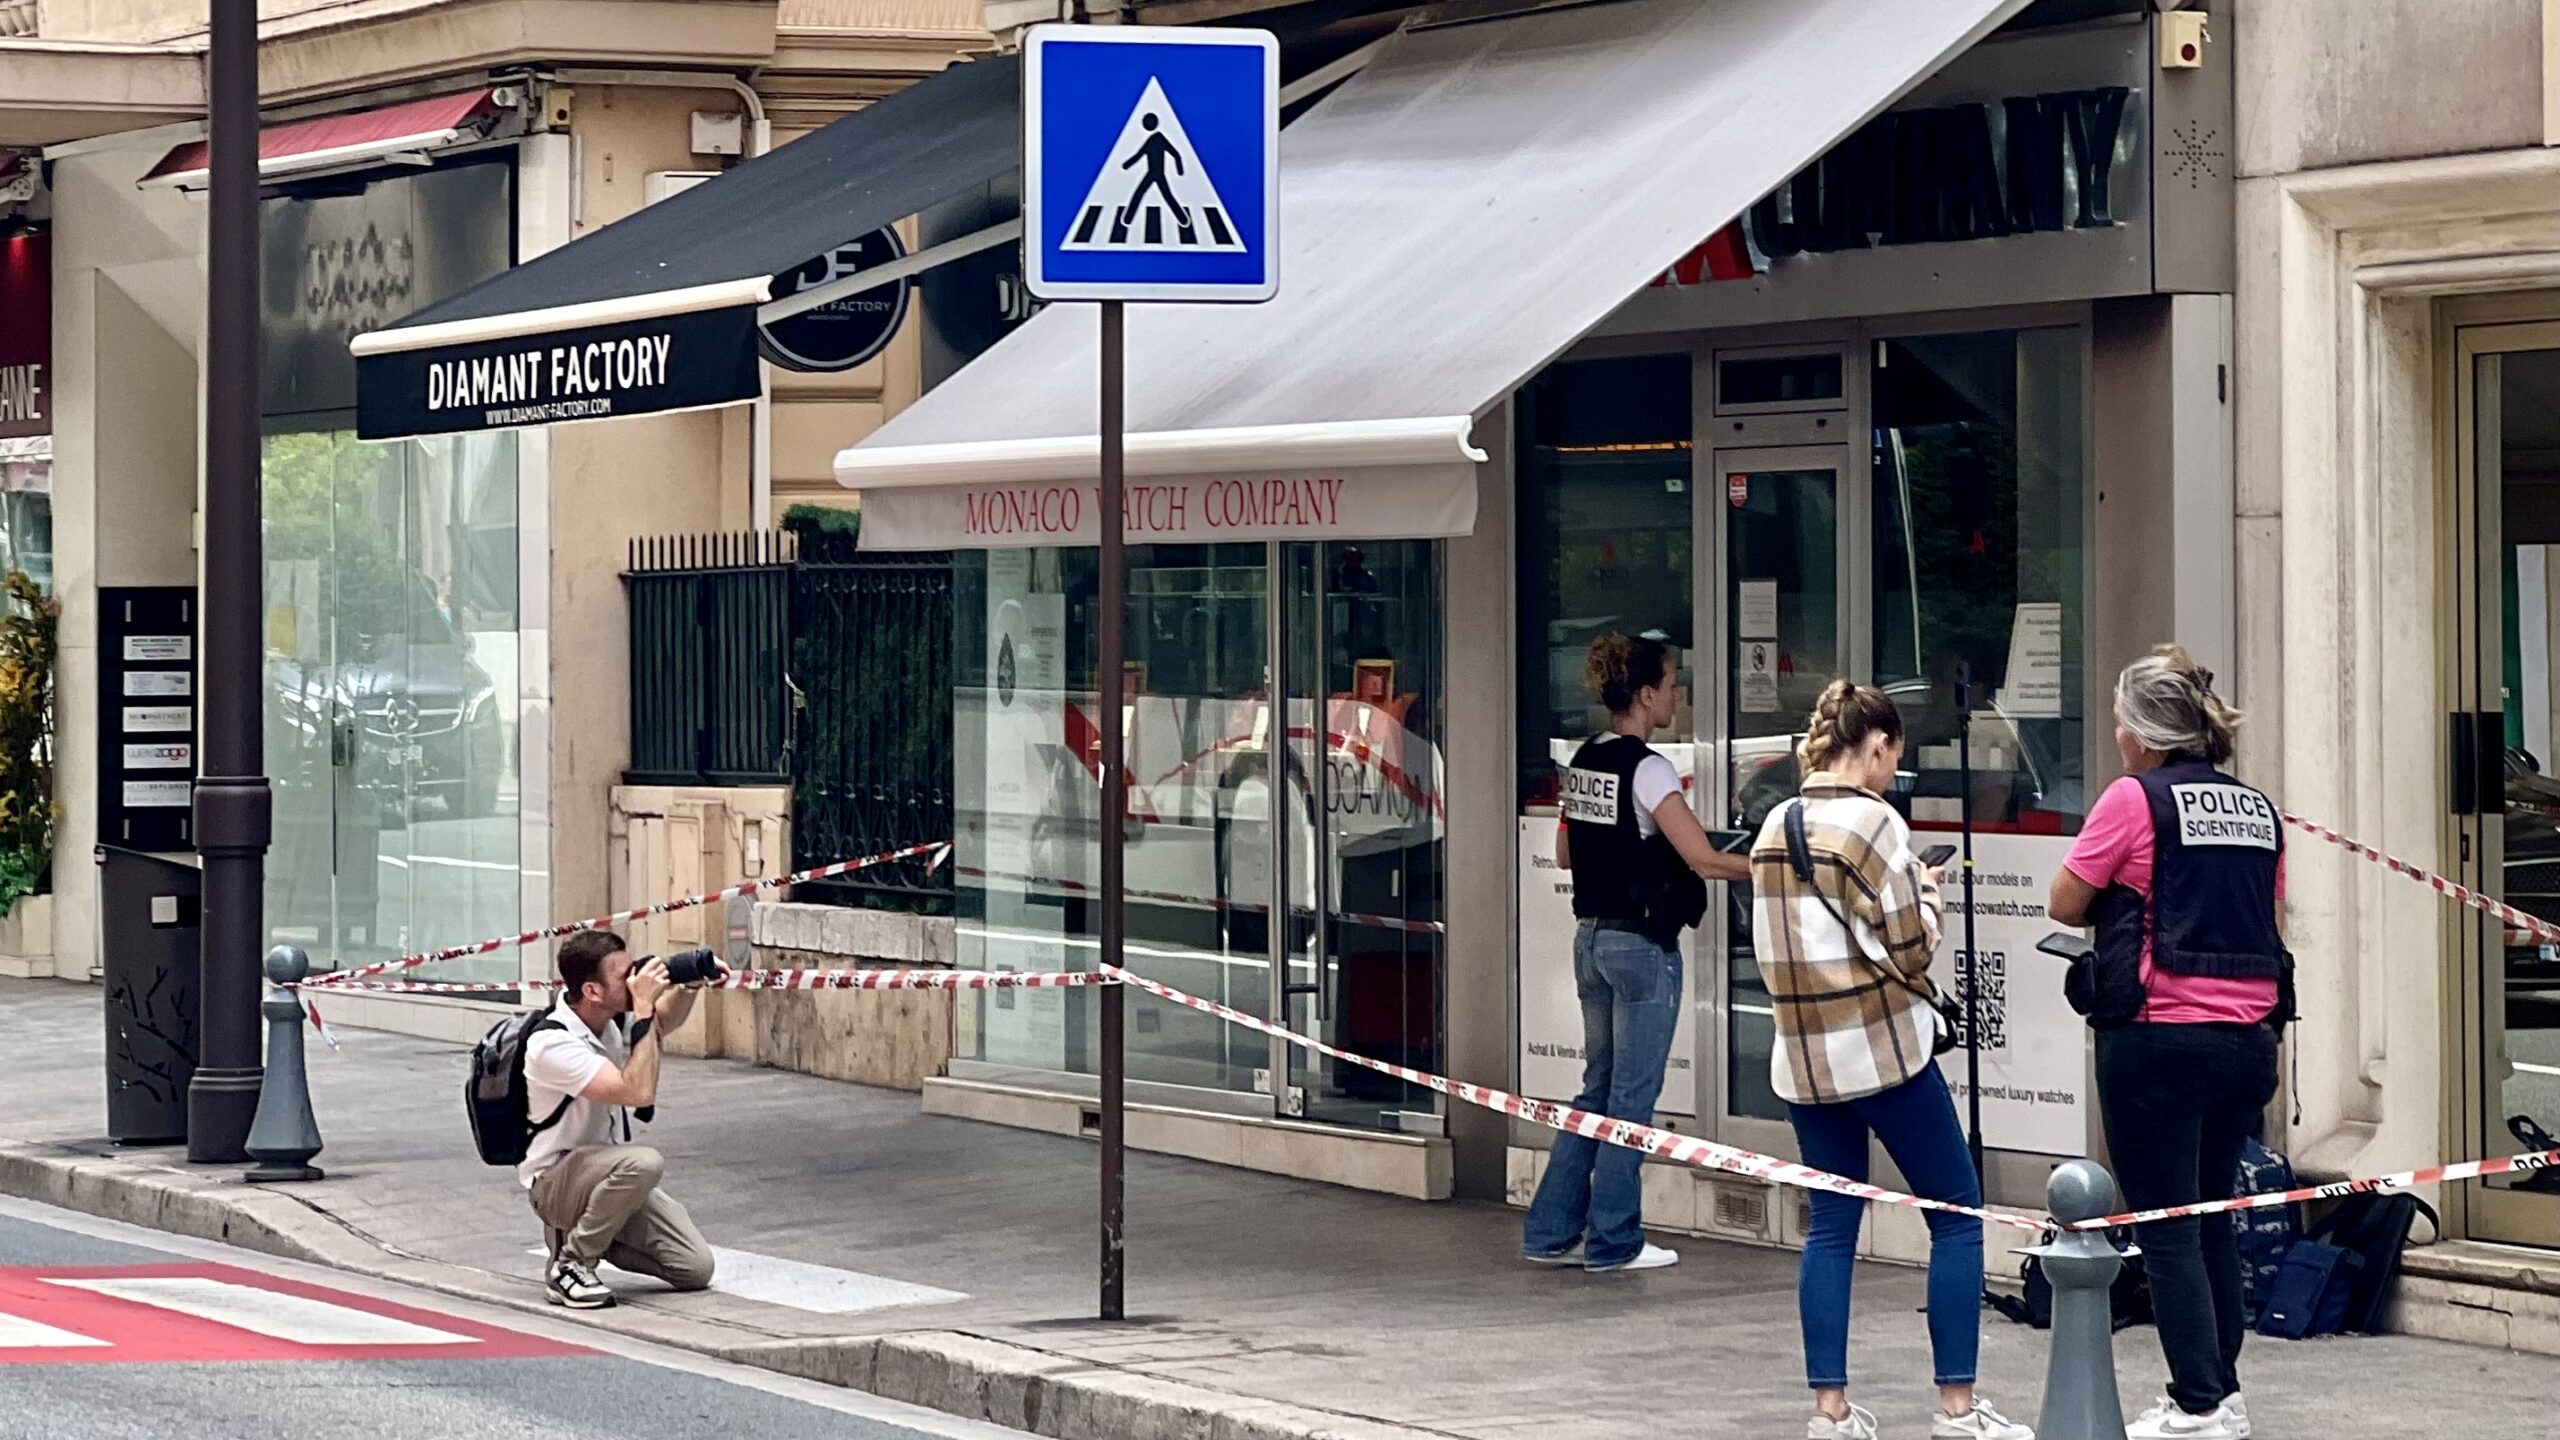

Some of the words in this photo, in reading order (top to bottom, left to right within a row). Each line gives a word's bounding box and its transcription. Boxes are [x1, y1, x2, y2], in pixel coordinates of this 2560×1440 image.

[829, 300, 891, 312] FACTORY
[428, 350, 542, 410] DIAMANT
[550, 334, 671, 397] FACTORY
[485, 398, 612, 425] WWW.DIAMANT-FACTORY.COM
[965, 487, 1080, 534] MONACO
[1204, 478, 1344, 528] COMPANY
[1567, 773, 1616, 800] OLICE
[2180, 790, 2269, 819] POLICE
[2186, 820, 2273, 842] SCIENTIFIQUE
[1986, 871, 2020, 887] models
[2021, 875, 2034, 887] on
[2008, 1085, 2035, 1106] luxury
[2037, 1089, 2076, 1105] watches
